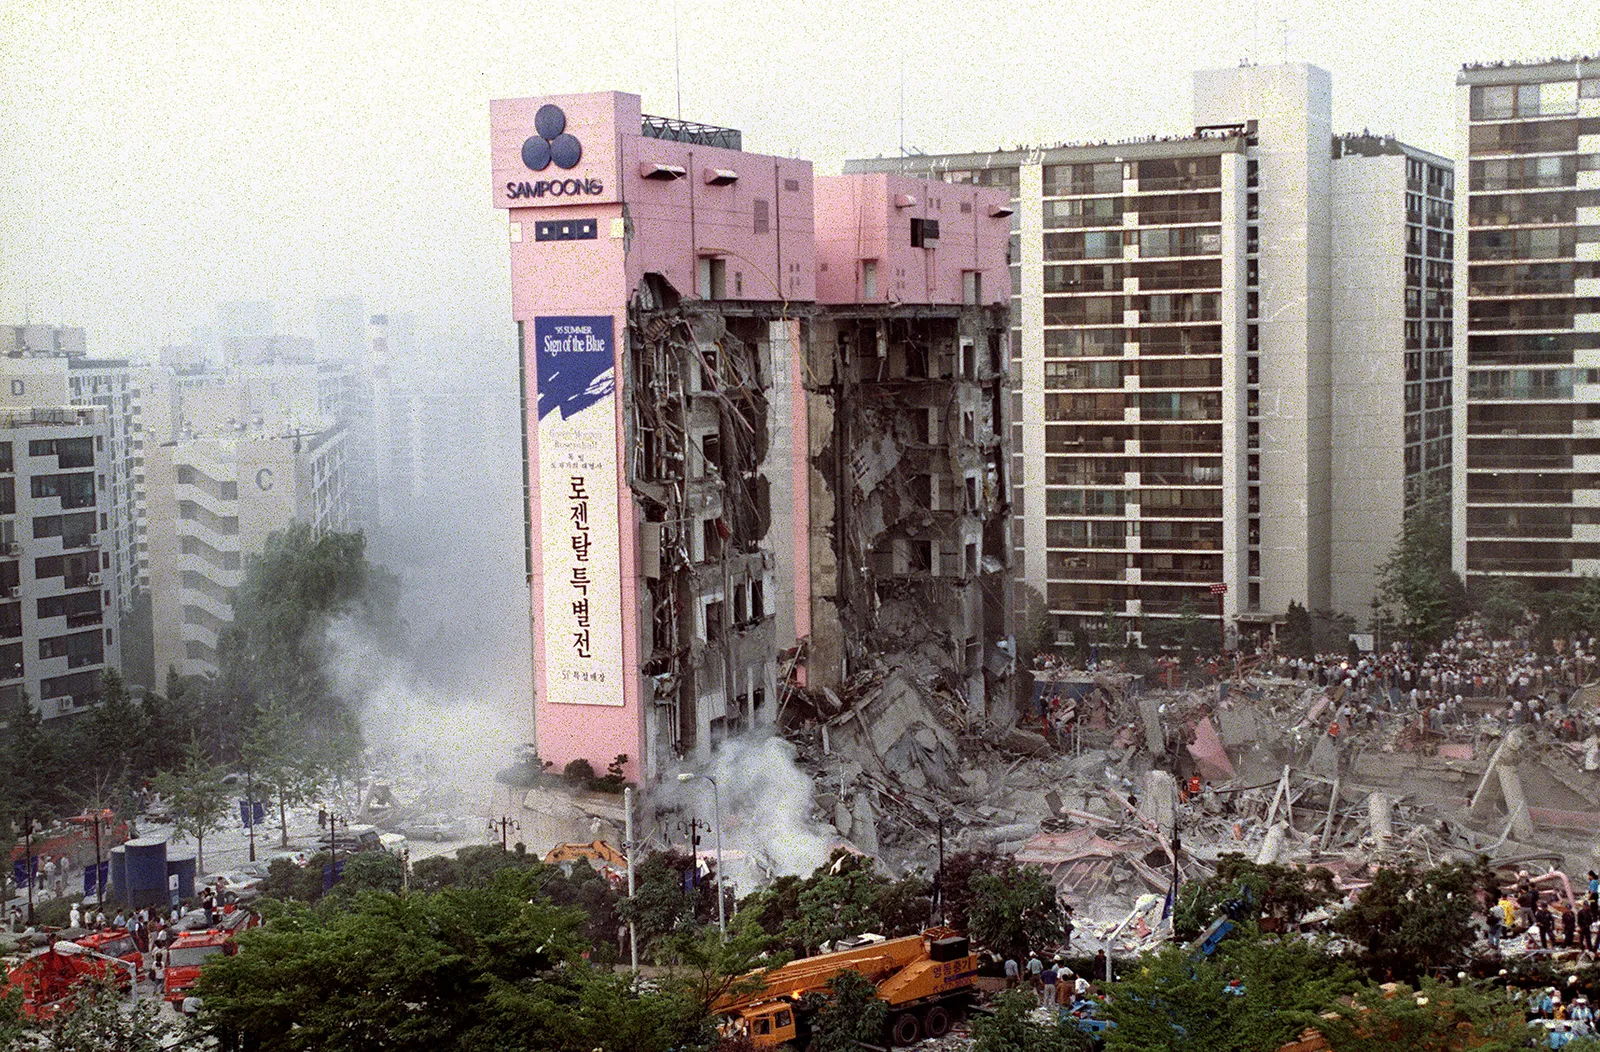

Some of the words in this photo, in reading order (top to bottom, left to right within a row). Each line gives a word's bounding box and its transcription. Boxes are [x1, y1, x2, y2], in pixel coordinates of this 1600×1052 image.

[506, 178, 603, 199] SAMPOONG
[564, 325, 593, 335] SUMMER
[544, 335, 562, 357] Sign
[563, 335, 572, 353] of
[573, 335, 585, 353] the
[586, 335, 605, 353] Blue
[11, 379, 25, 396] D
[256, 468, 273, 491] C
[568, 476, 592, 562] 로젠탈
[570, 566, 592, 659] 특별전
